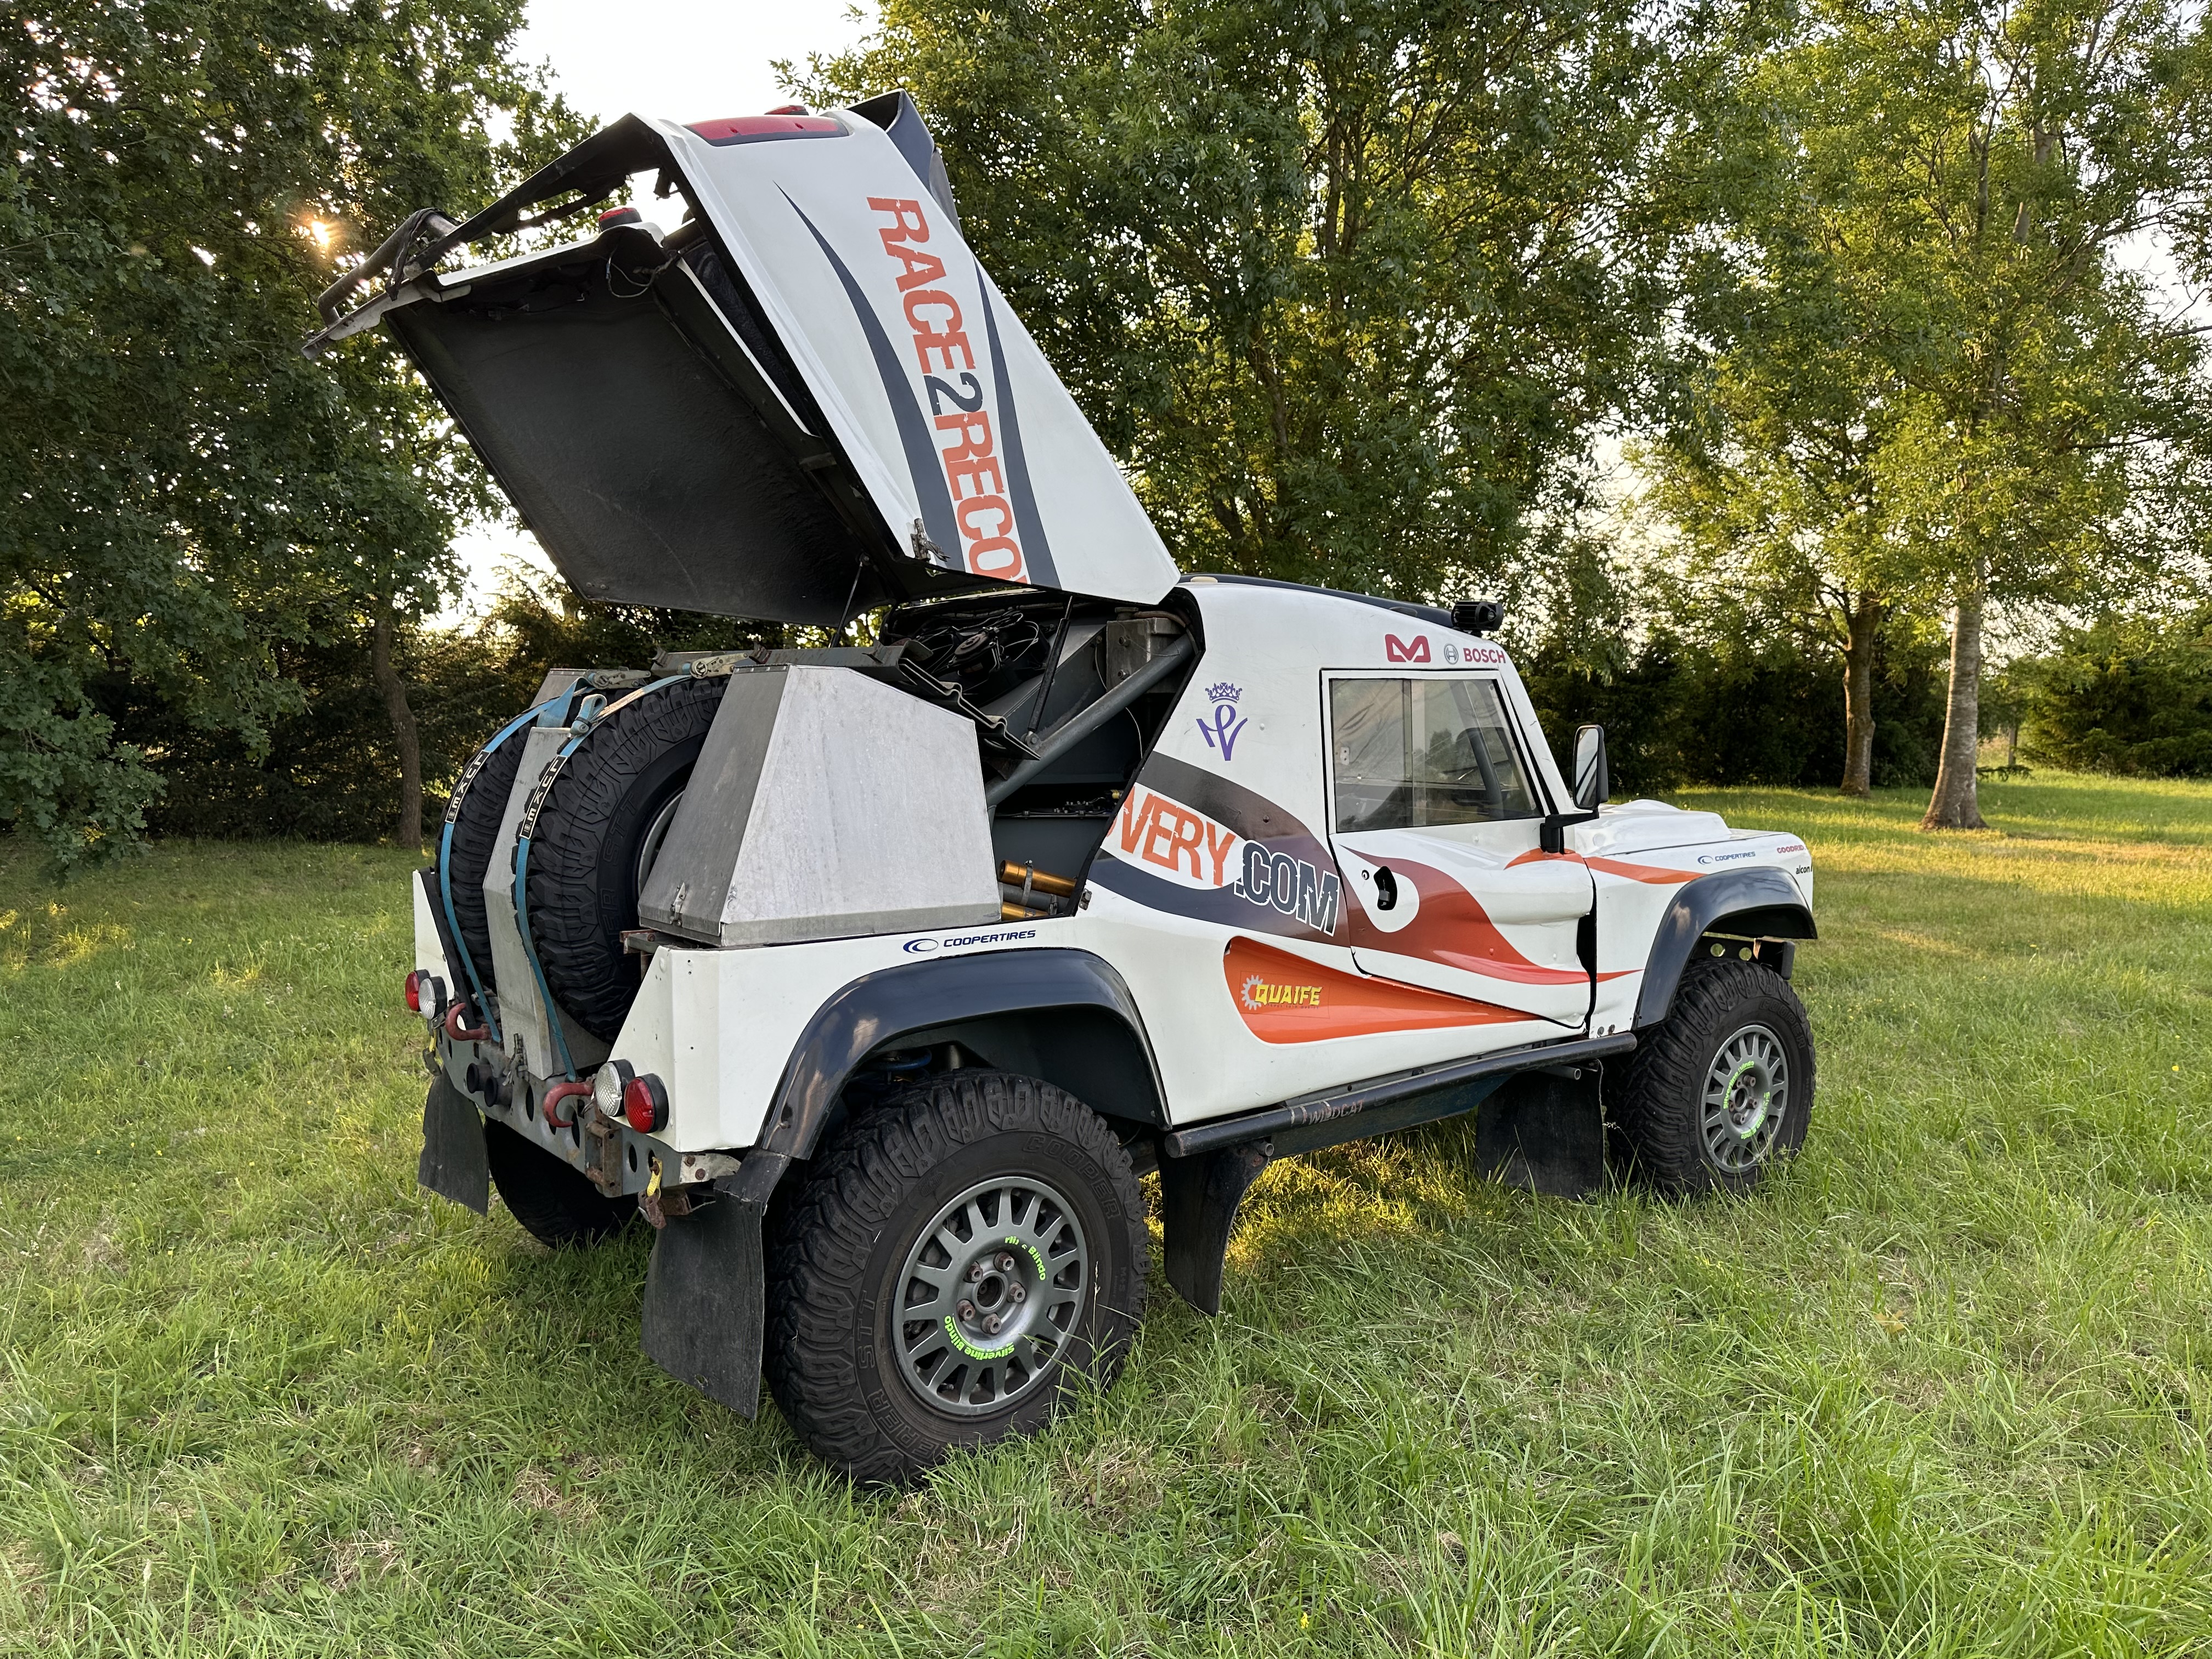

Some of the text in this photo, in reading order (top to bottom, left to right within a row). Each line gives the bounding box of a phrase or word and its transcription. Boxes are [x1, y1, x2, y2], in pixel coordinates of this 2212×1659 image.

[866, 197, 1031, 584] RACE2RECO
[1463, 647, 1506, 664] BOSCH
[452, 754, 484, 809] LUKE
[527, 759, 559, 821] LUKE
[1107, 786, 1340, 936] VERY.COM
[1715, 851, 1756, 861] COOPERTIRES
[1777, 844, 1806, 854] GOODRID
[1796, 865, 1810, 874] alcon
[943, 929, 1036, 947] COOPERTIRES
[1255, 984, 1323, 1006] QUAIFE
[1760, 999, 1805, 1048] COOPER
[1023, 1135, 1120, 1220] COOPER
[1028, 1245, 1046, 1280] Blindo
[857, 1289, 876, 1369] STT
[944, 1315, 1015, 1361] Silverline Blindo
